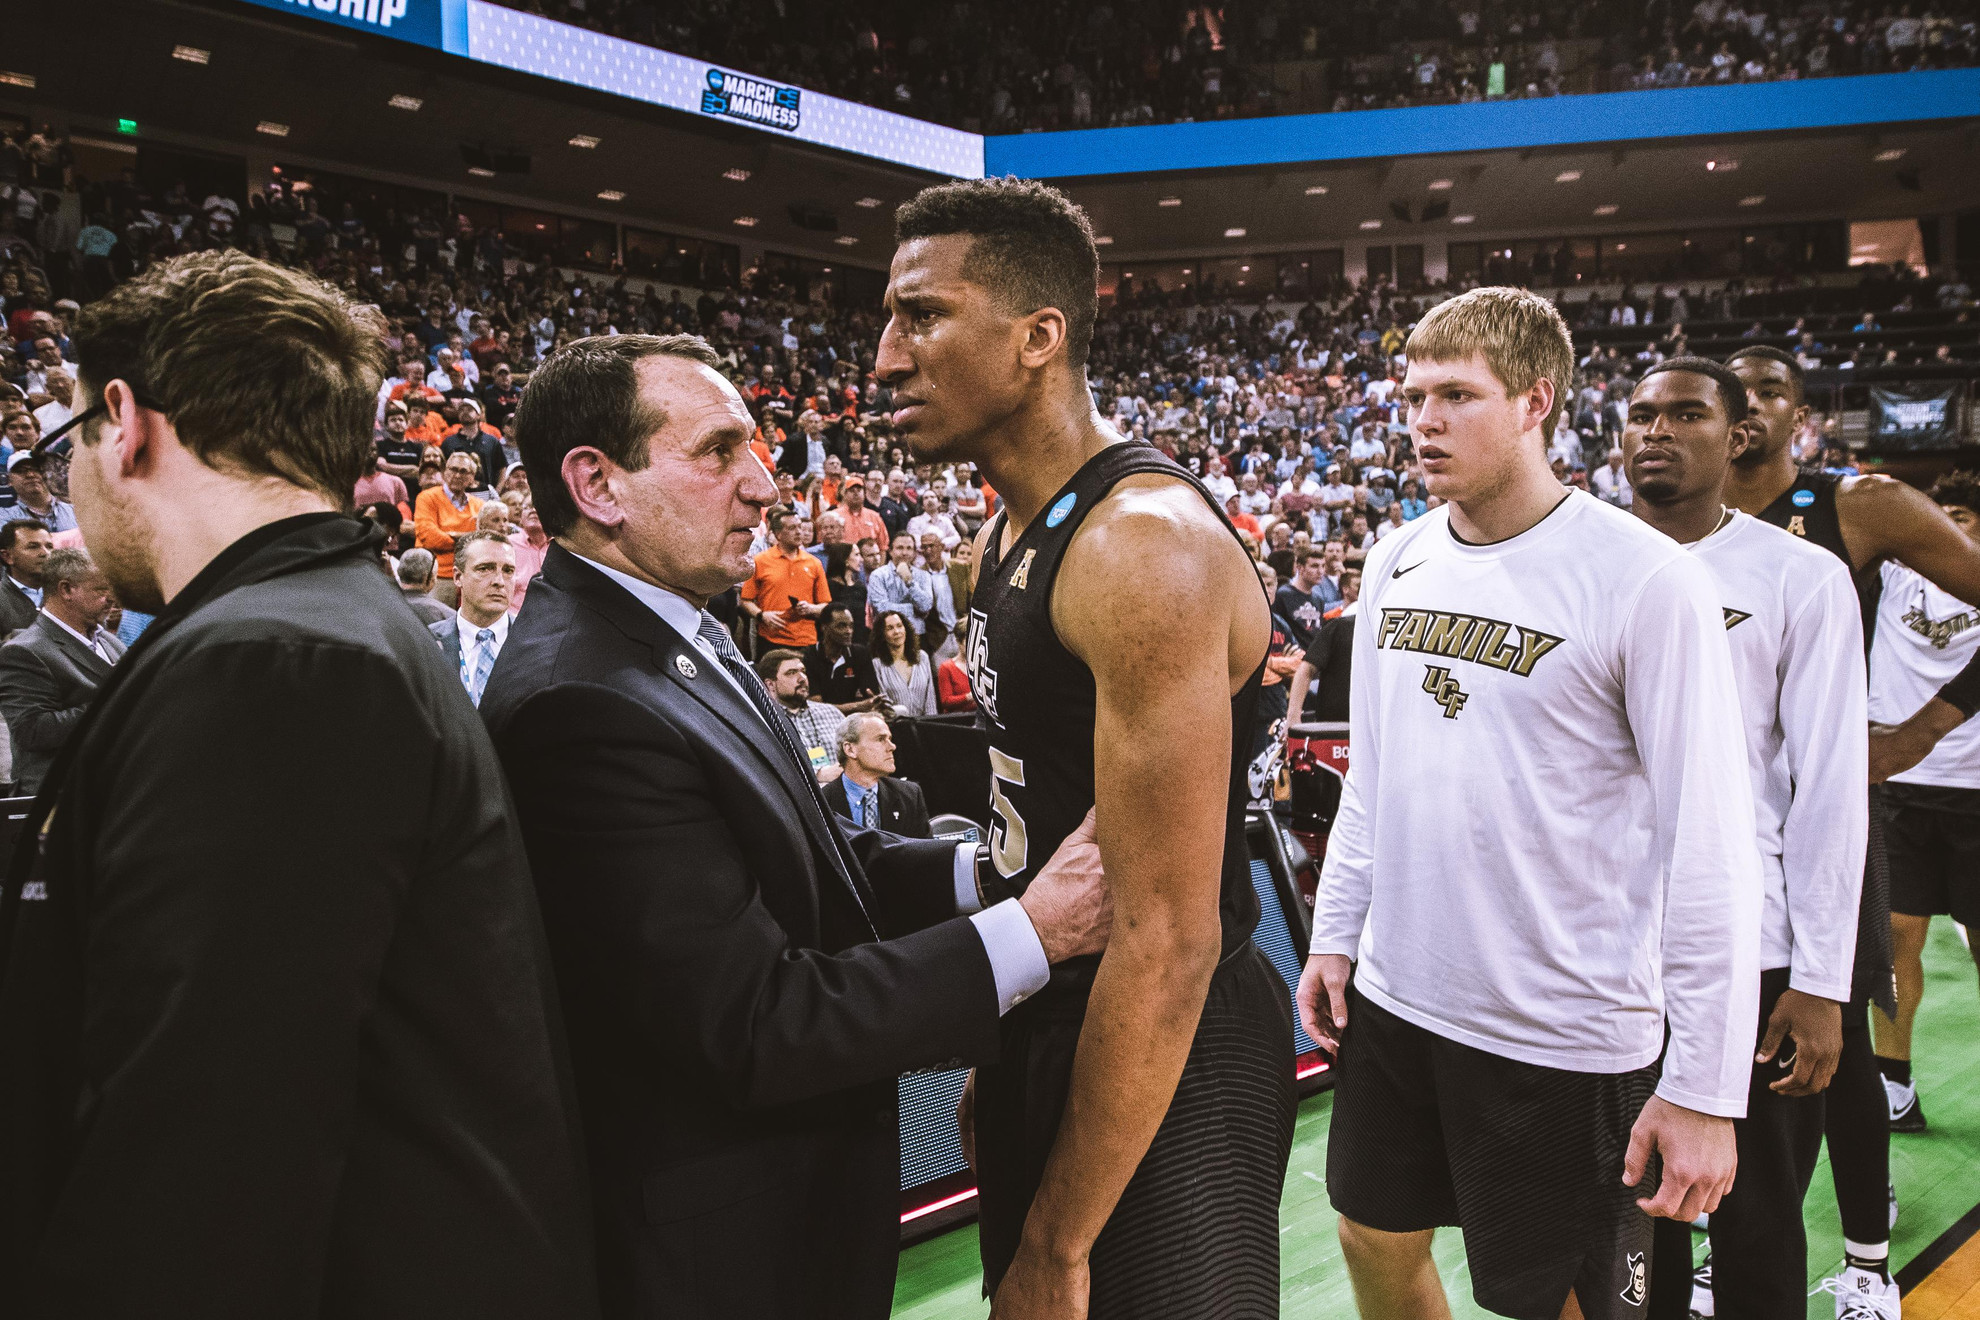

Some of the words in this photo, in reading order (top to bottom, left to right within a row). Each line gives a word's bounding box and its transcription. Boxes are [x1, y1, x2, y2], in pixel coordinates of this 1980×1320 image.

[723, 75, 775, 103] MARCH
[730, 94, 799, 126] MADNESS
[1009, 549, 1037, 590] A
[1377, 608, 1566, 678] FAMILY
[1421, 663, 1470, 720] UCF
